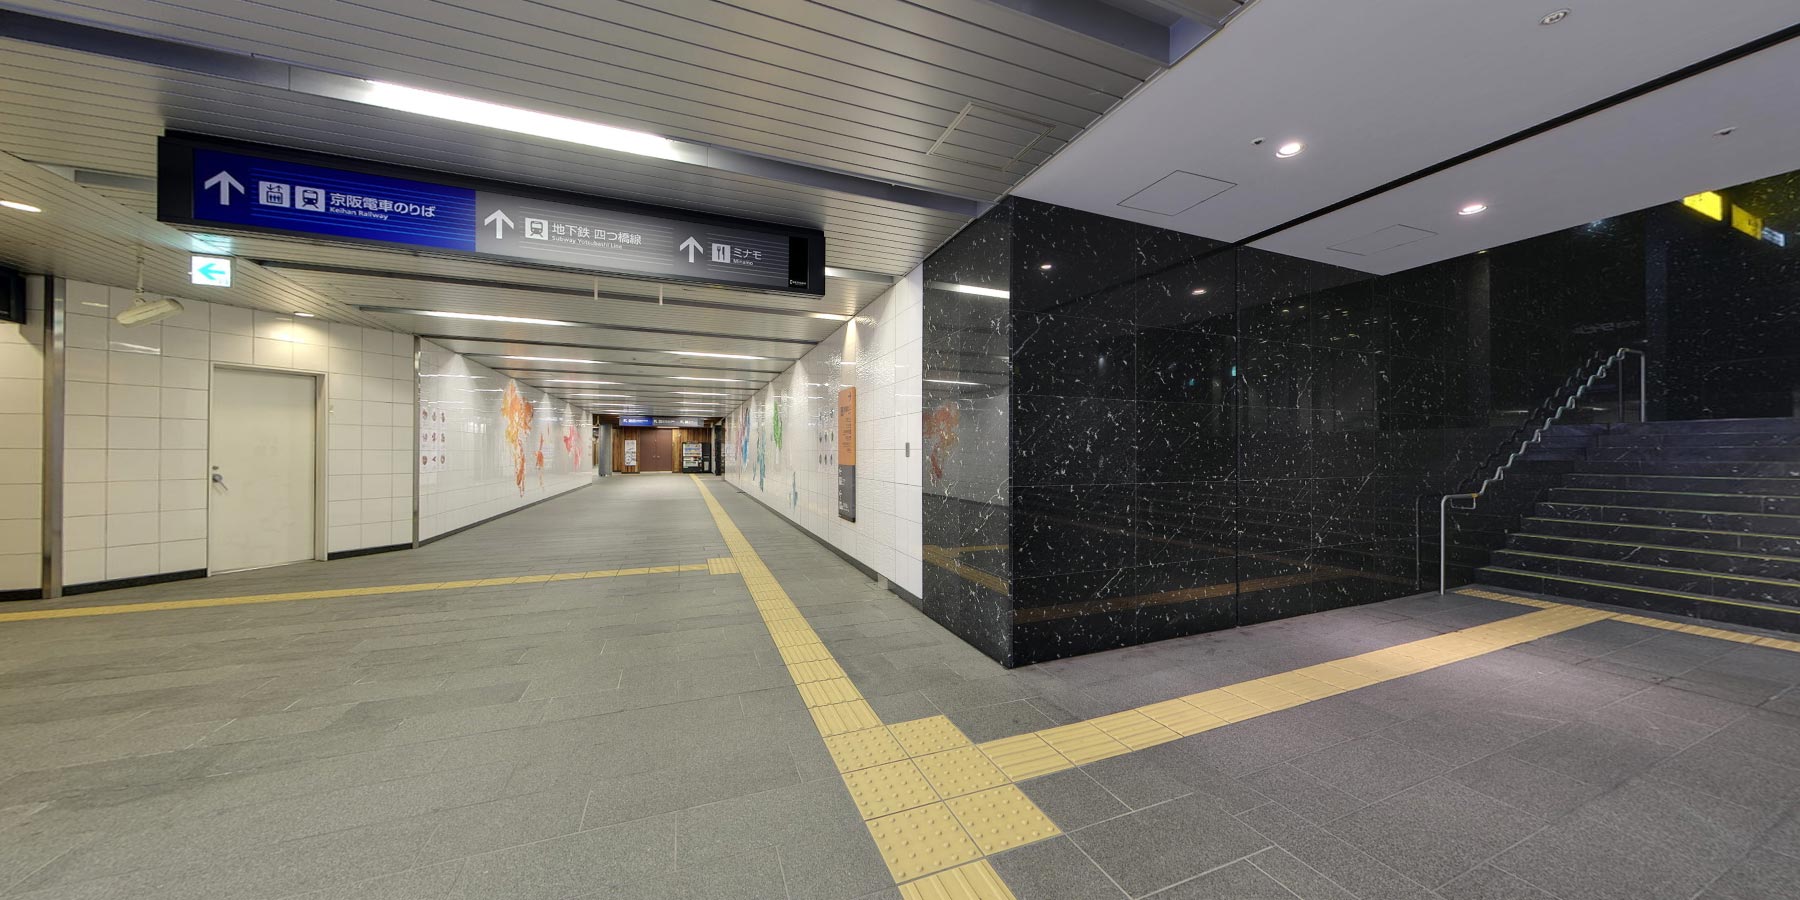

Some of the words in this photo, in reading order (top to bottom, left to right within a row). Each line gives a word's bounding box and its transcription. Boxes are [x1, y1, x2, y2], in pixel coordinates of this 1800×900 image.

[330, 193, 436, 217] 京阪電車のりば
[330, 206, 357, 216] Keihan
[358, 210, 388, 220] Railway
[551, 235, 576, 244] Subway
[552, 222, 590, 239] 地下鉄
[594, 229, 642, 245] 四つ橋線
[733, 247, 762, 260] ミナモ
